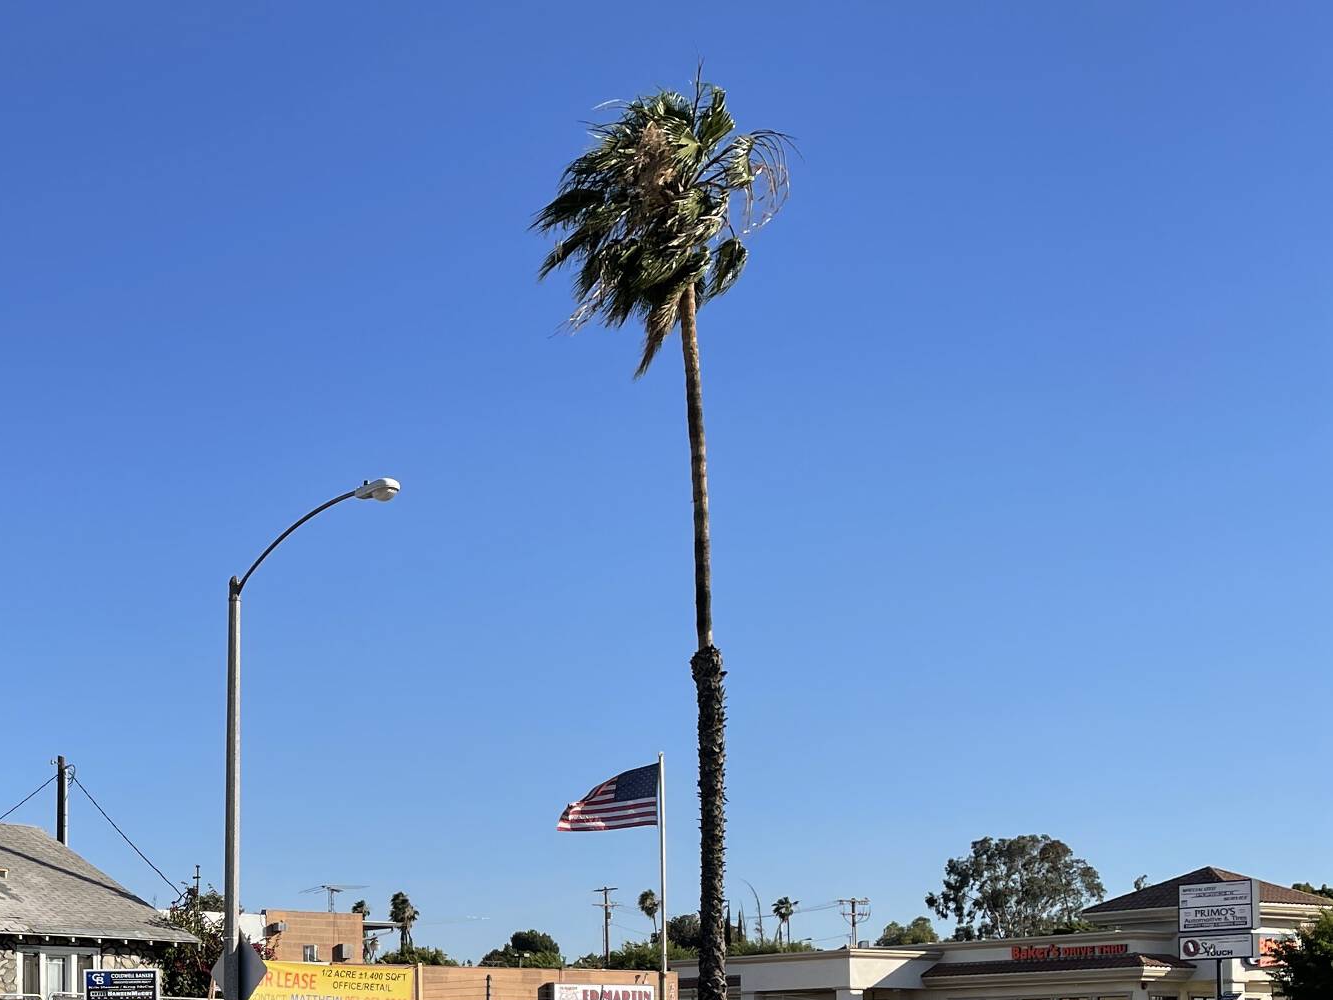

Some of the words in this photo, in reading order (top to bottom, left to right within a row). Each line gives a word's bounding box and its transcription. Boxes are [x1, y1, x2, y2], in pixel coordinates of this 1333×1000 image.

[1194, 908, 1236, 918] PRIMO'S
[1011, 944, 1060, 960] Baker's
[1062, 946, 1095, 956] DRIVE
[1097, 944, 1128, 954] THRU
[276, 971, 317, 990] LEASE
[322, 969, 333, 978] 1/2
[334, 970, 357, 979] ACRE
[385, 972, 407, 982] SQFT
[332, 981, 393, 992] OFFICE/RETAIL
